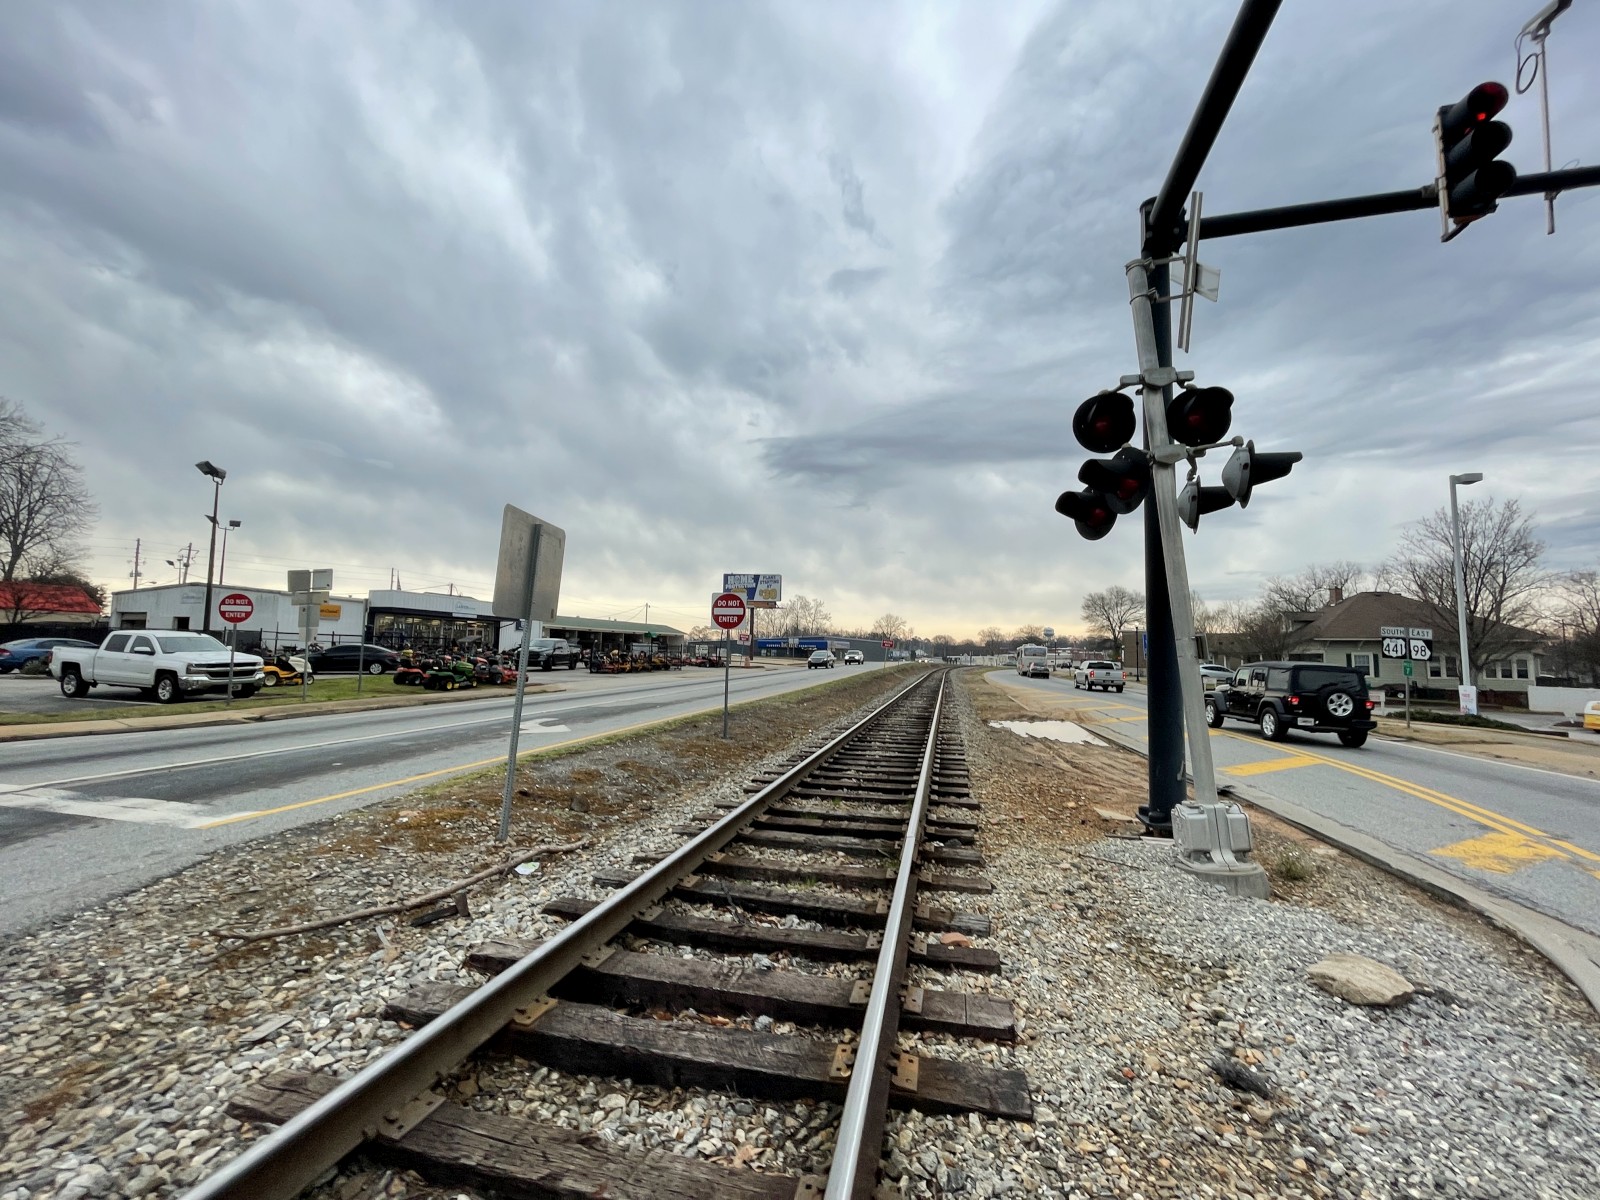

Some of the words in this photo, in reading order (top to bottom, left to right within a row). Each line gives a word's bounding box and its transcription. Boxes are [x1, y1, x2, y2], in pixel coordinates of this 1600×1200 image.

[728, 574, 754, 584] HOME
[1412, 629, 1429, 637] EAST
[1384, 643, 1402, 654] 441
[1413, 645, 1426, 657] 98
